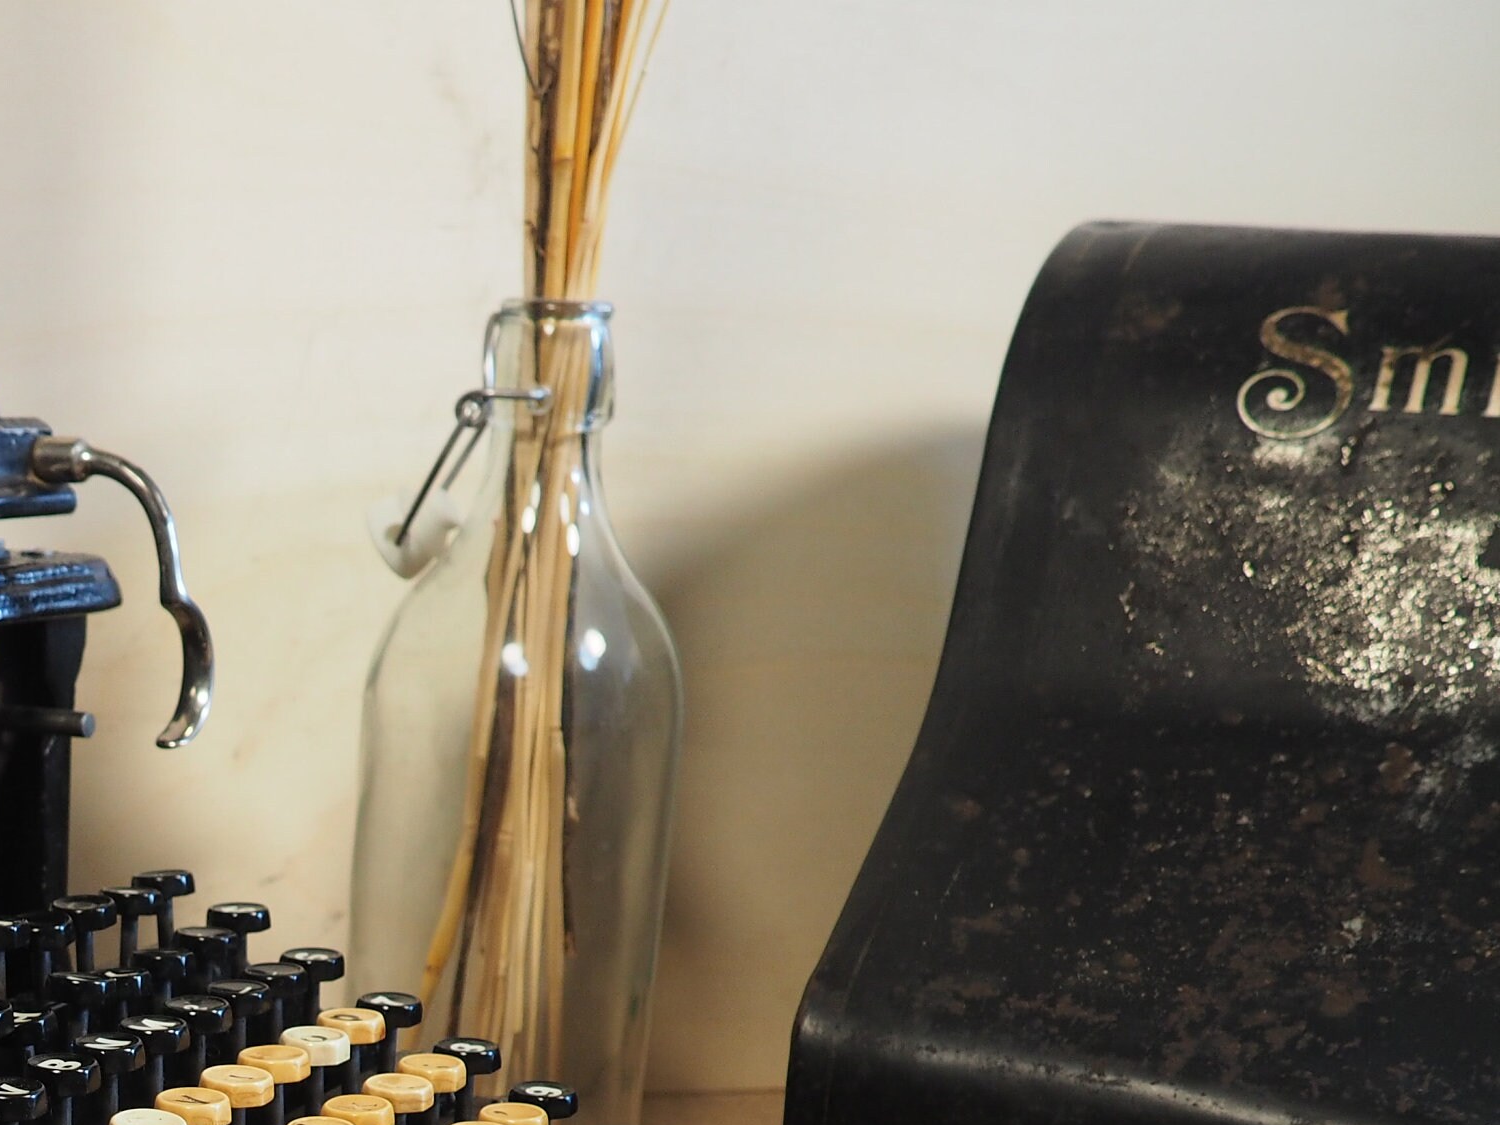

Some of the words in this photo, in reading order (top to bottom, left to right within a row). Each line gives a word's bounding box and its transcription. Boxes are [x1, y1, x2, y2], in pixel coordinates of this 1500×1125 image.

[450, 1042, 486, 1053] 8
[37, 1058, 83, 1071] B
[525, 1086, 563, 1098] 9
